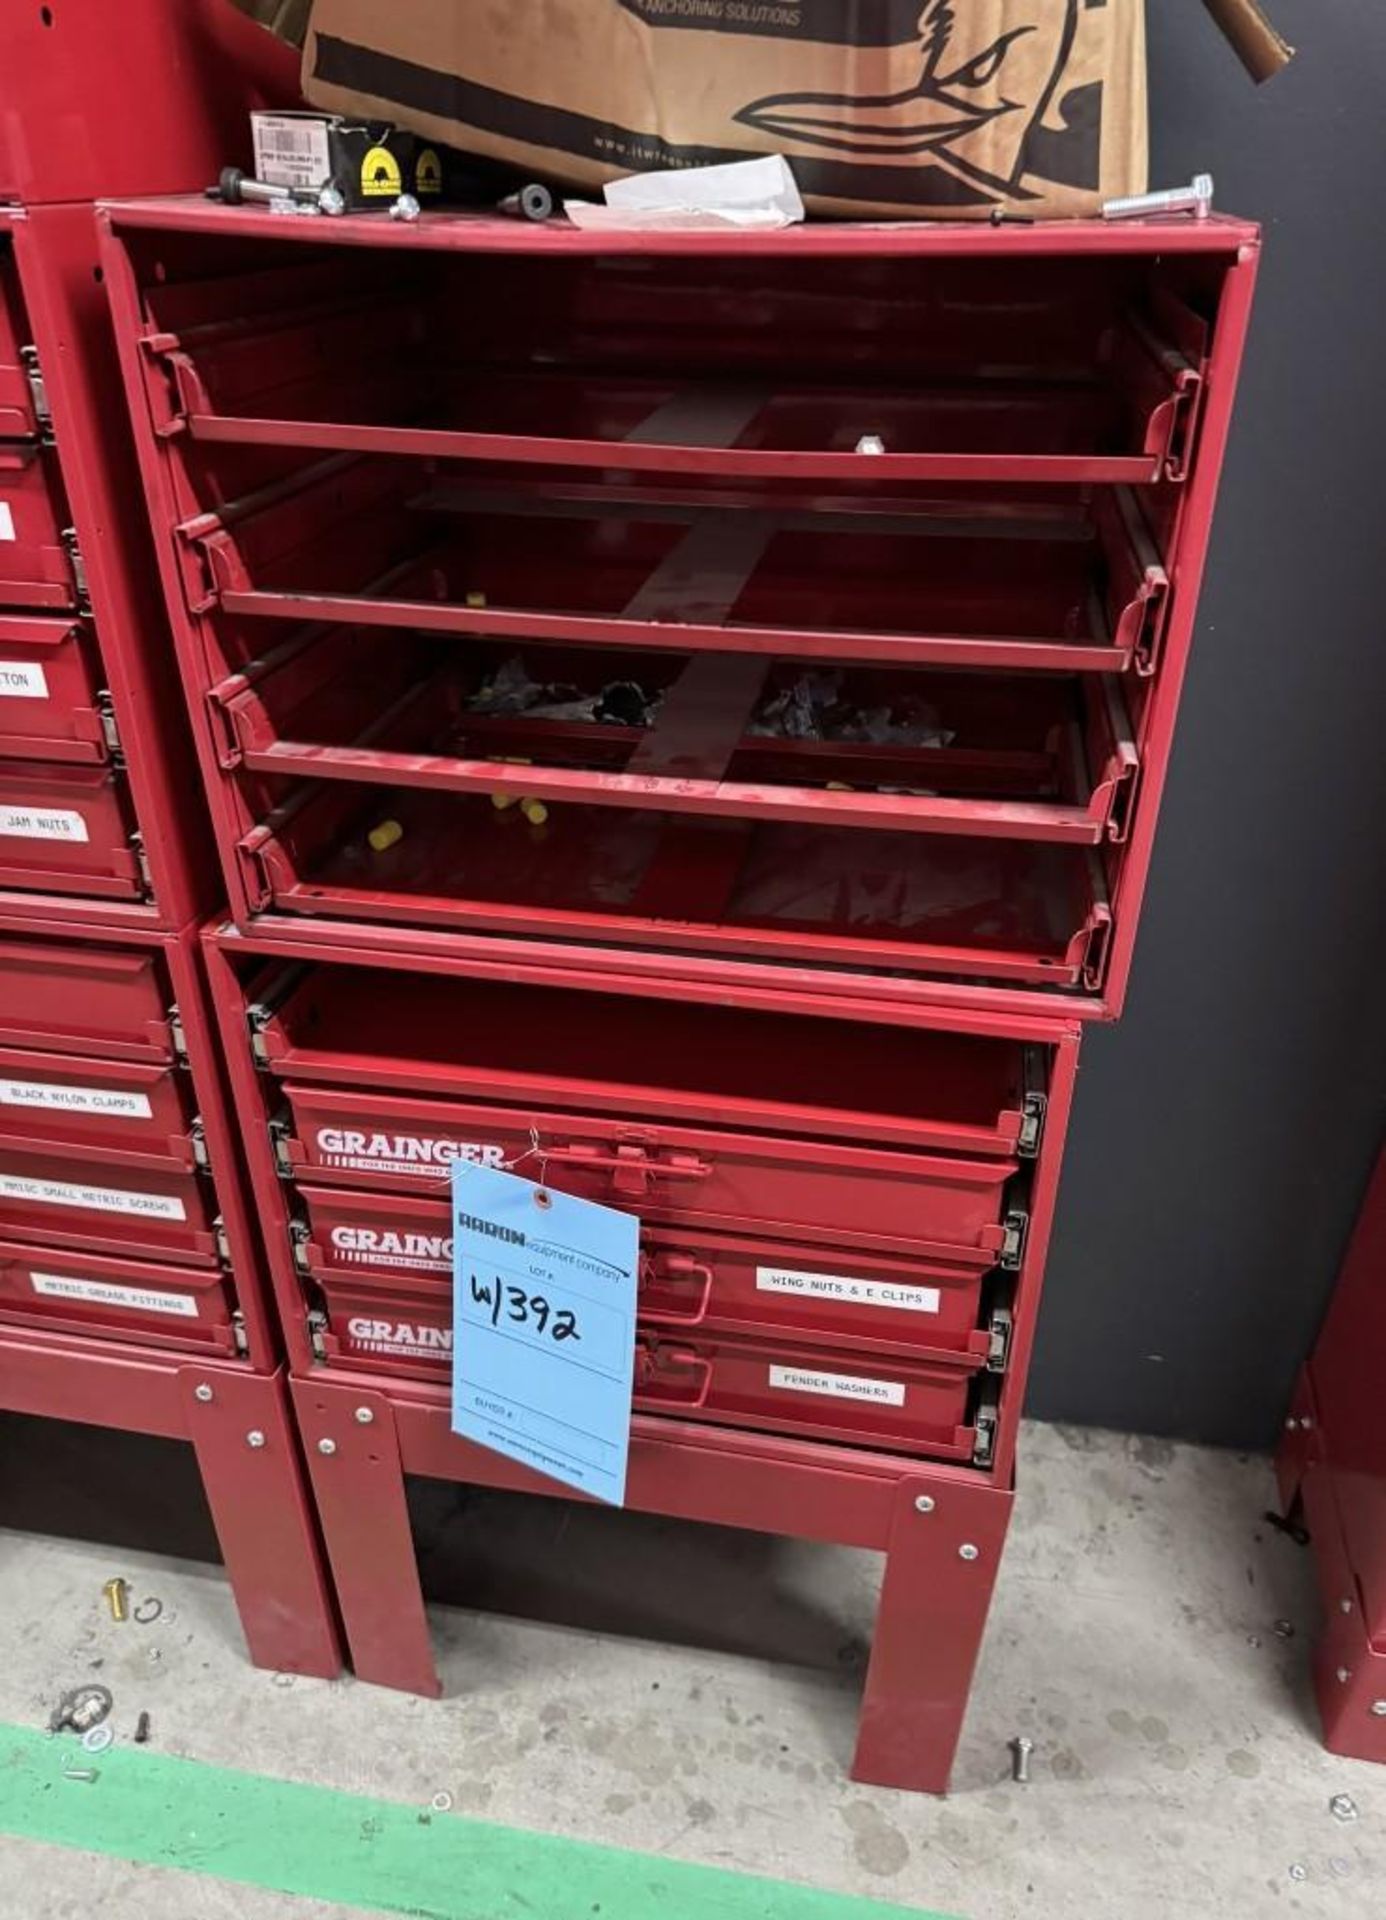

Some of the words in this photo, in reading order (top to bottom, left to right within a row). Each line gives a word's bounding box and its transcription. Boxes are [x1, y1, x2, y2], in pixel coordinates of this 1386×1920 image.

[725, 3, 801, 26] SOLUTIONS
[0, 671, 29, 687] TON
[7, 816, 31, 828] JAM
[36, 818, 71, 832] NUTS
[11, 1088, 46, 1101] BLACK
[51, 1092, 87, 1105] NYLON
[93, 1096, 136, 1110] CLAMPS
[458, 1212, 527, 1248] AARON
[770, 1275, 804, 1288] WING
[810, 1280, 843, 1293] NUTS
[850, 1286, 859, 1295] &
[866, 1288, 873, 1297] E
[881, 1290, 923, 1303] CLIPS
[784, 1374, 829, 1388] FENDER
[836, 1382, 889, 1398] WASHERS
